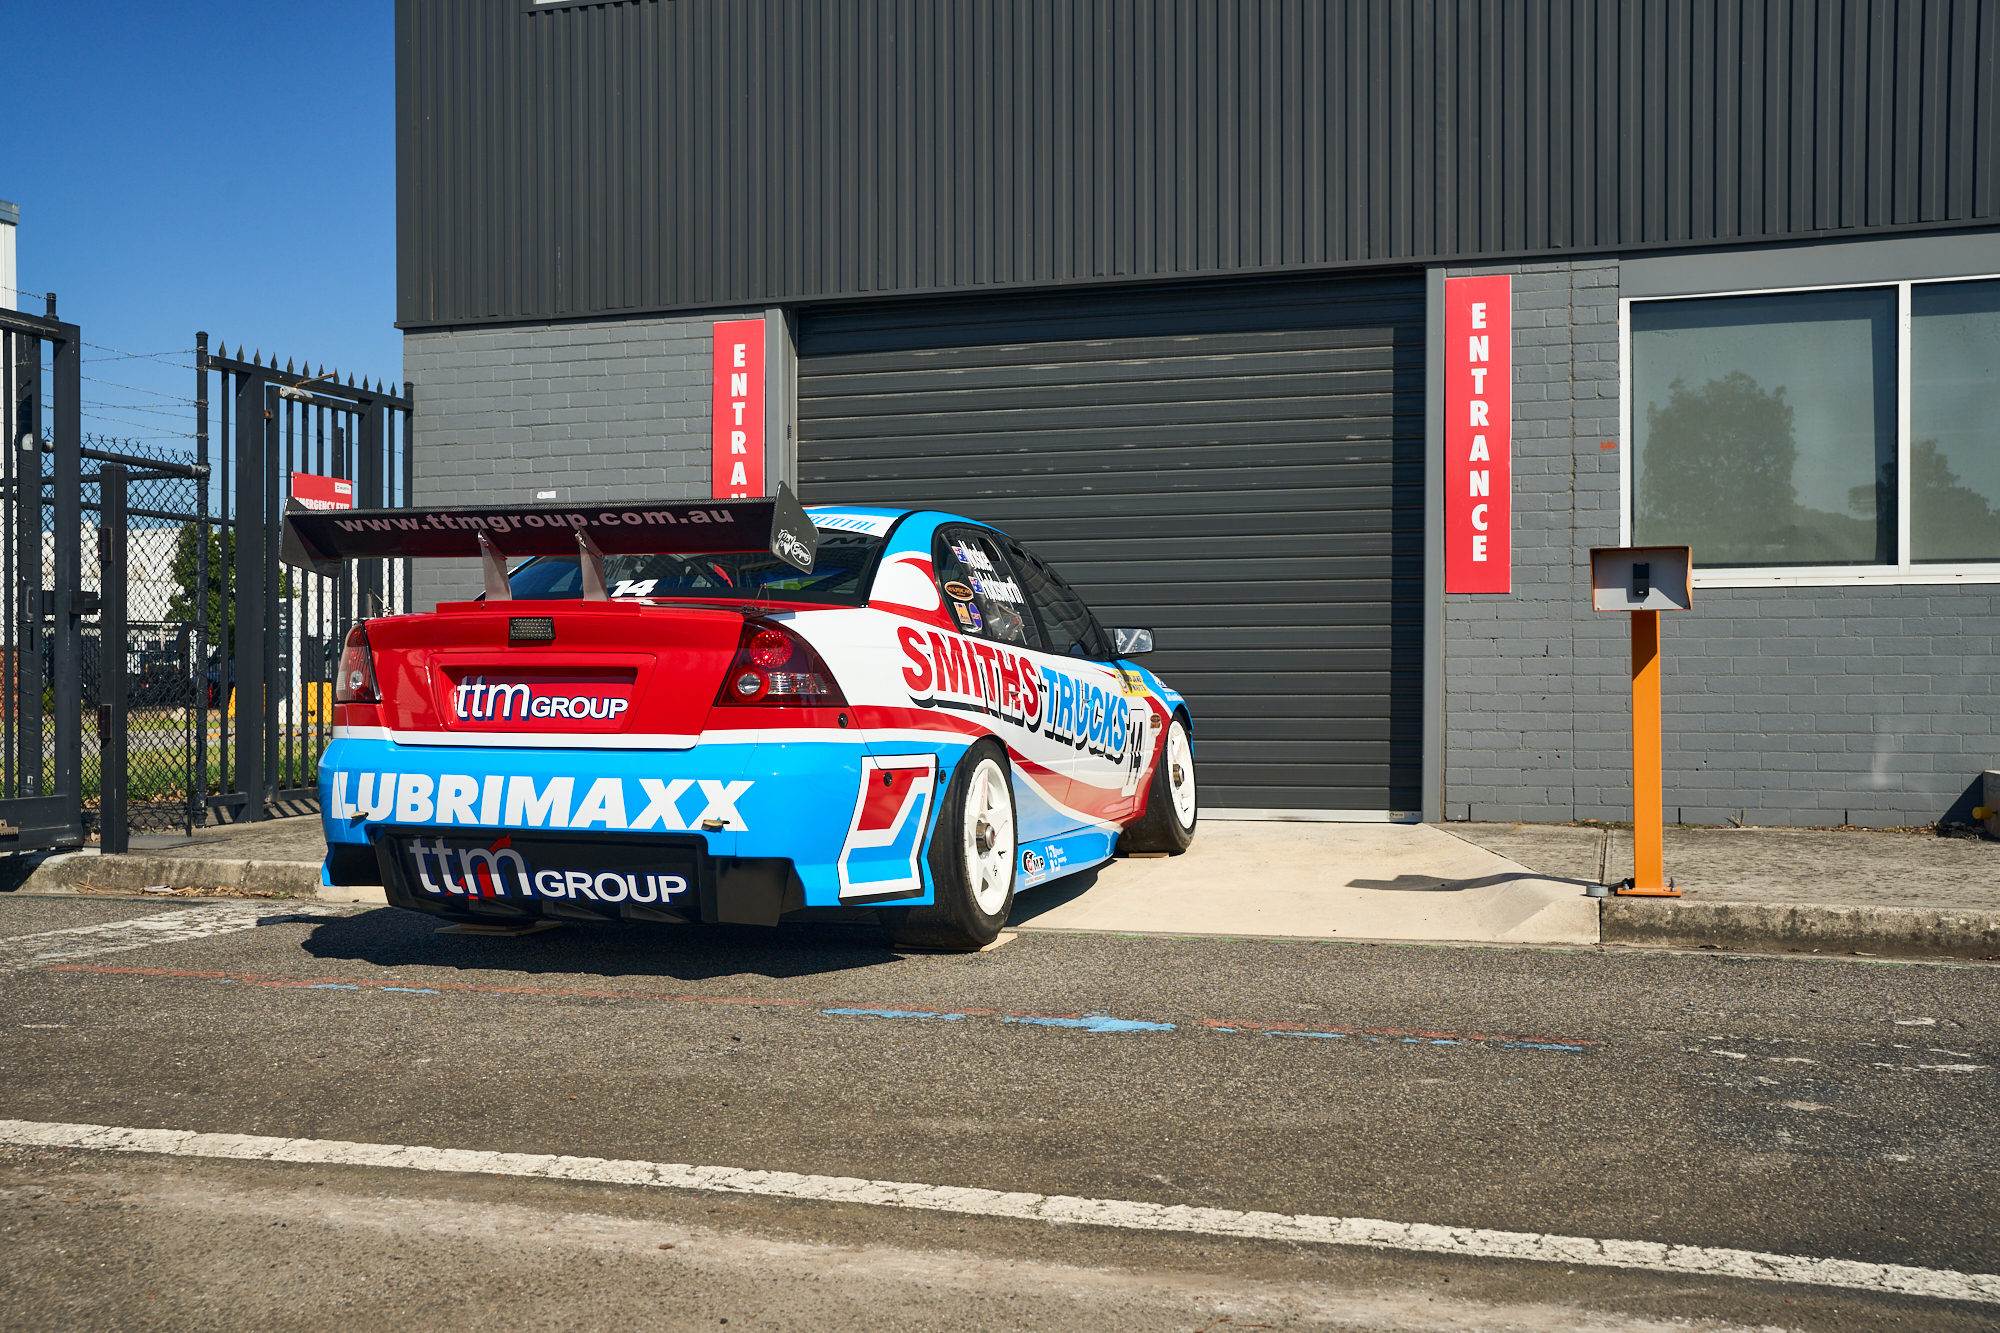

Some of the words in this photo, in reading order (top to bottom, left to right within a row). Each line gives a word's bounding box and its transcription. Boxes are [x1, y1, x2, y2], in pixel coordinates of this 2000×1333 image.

[731, 343, 747, 498] ENTRA
[1469, 302, 1490, 562] ENTRANCE
[334, 506, 735, 533] www.ttmgroup.com.au
[336, 502, 350, 510] EXIT
[610, 579, 658, 597] 14
[457, 674, 530, 718] ttm
[531, 696, 629, 719] GROUP
[897, 626, 1039, 719] SMITHS
[1040, 665, 1128, 752] TRUCKS
[331, 772, 755, 831] LUBRIMAXX
[408, 836, 533, 897] ttm
[535, 869, 688, 904] GROUP
